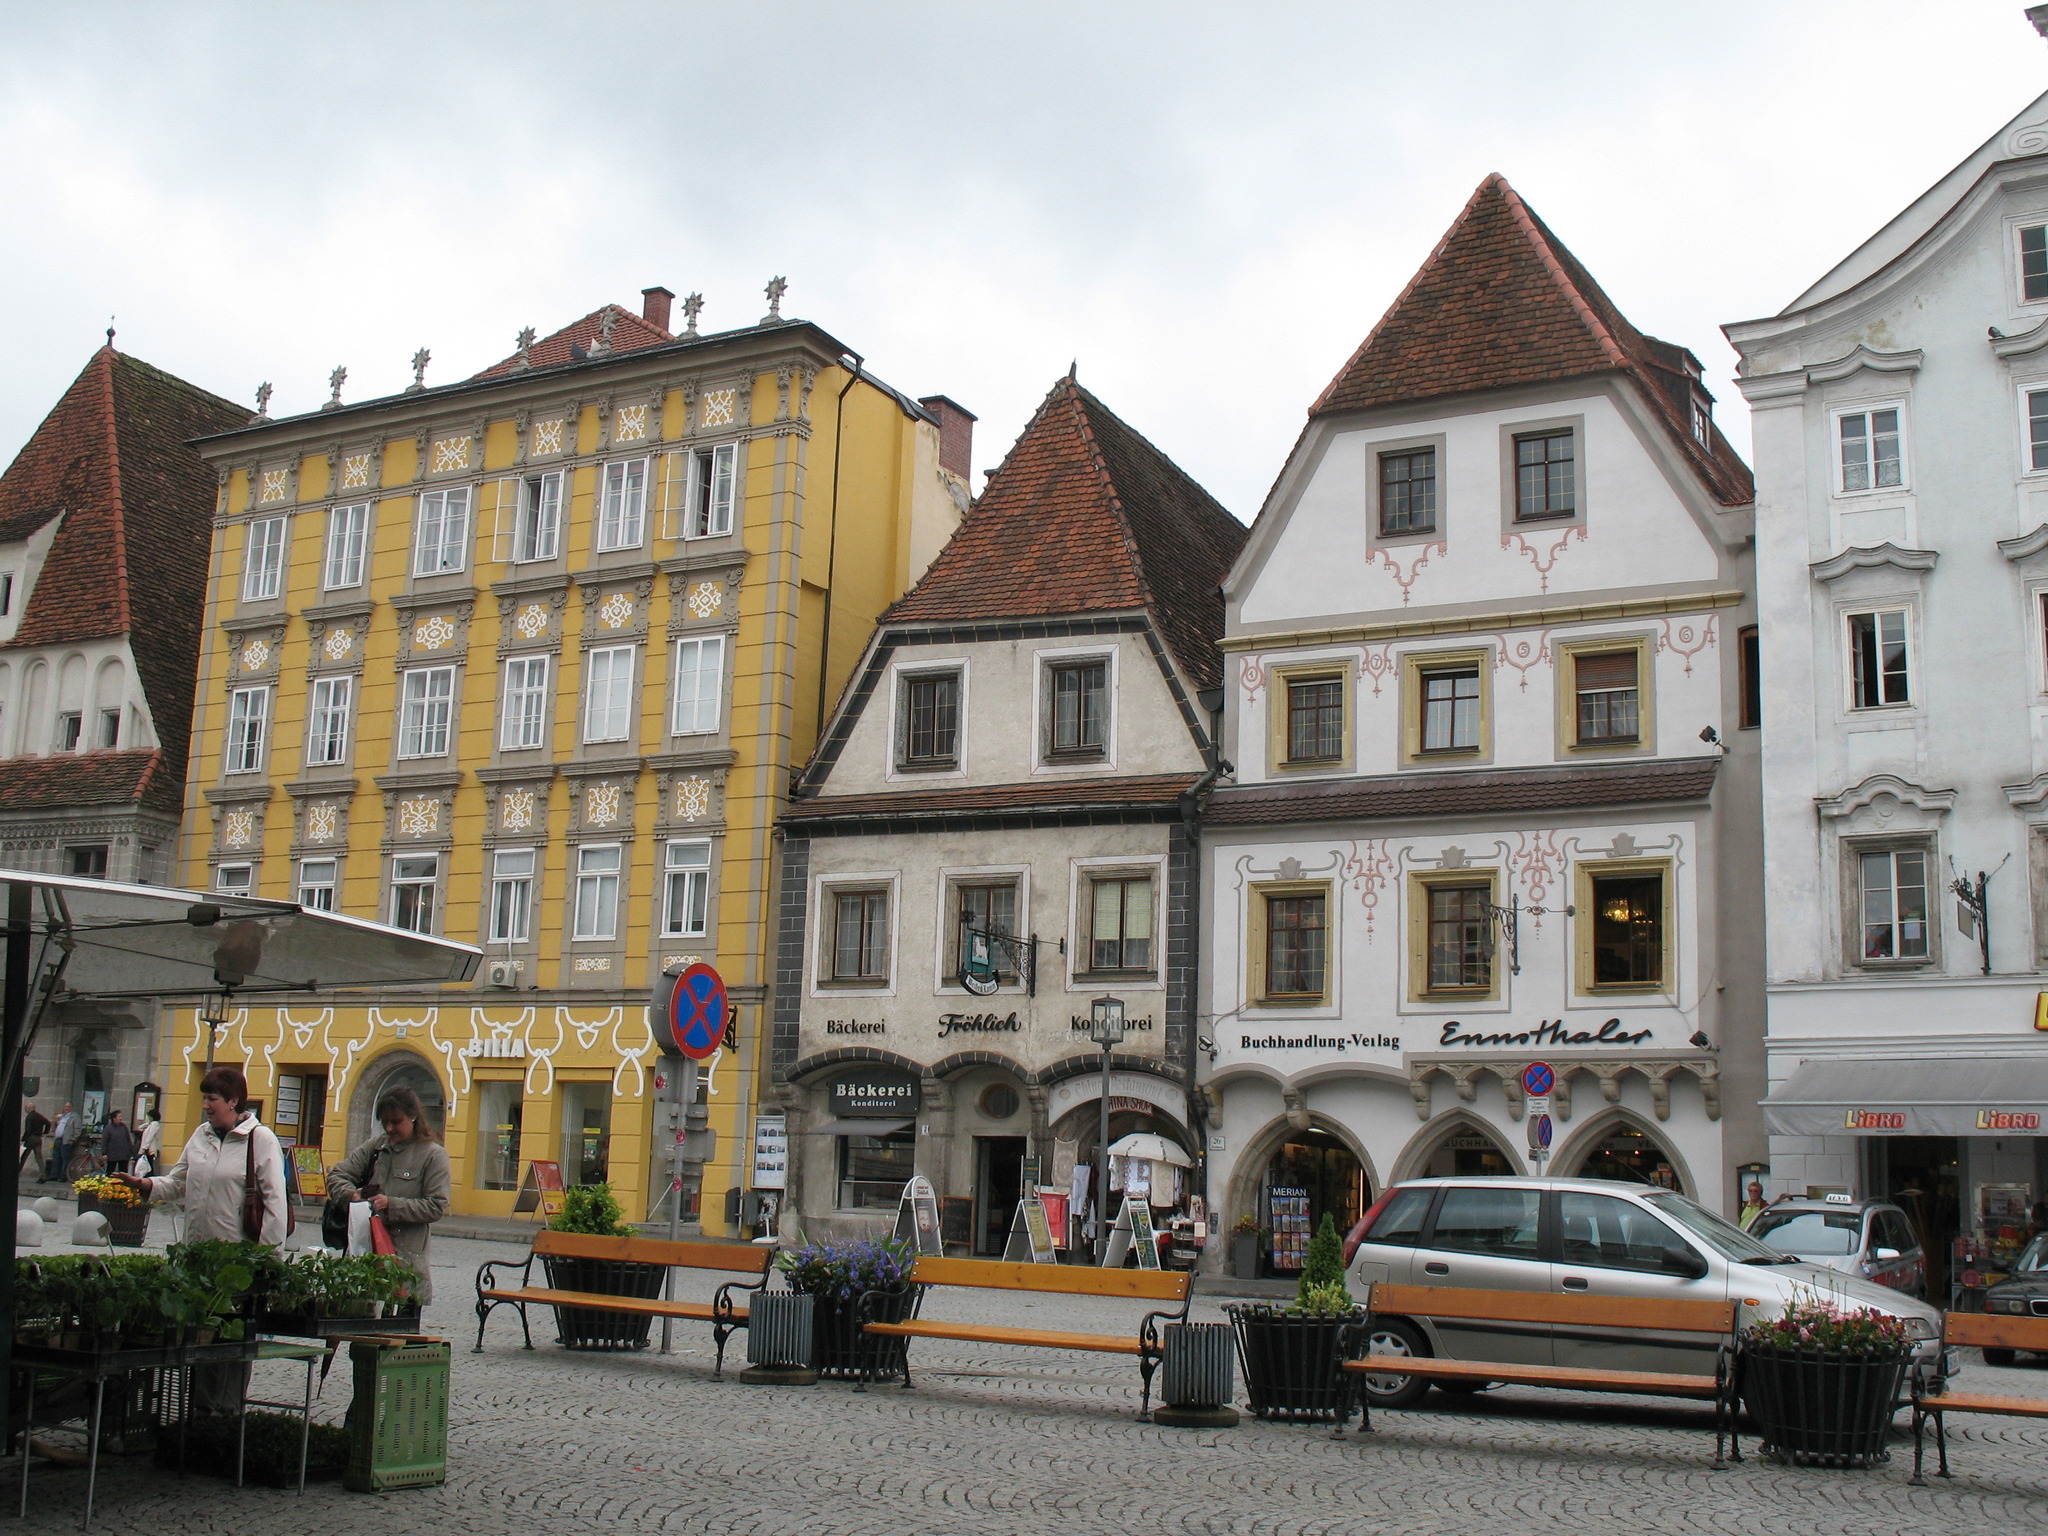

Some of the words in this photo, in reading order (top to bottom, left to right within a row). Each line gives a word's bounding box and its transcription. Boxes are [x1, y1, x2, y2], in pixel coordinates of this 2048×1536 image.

[827, 1018, 885, 1034] Bäckerei
[938, 1012, 1021, 1038] Fröhlich
[1440, 1018, 1653, 1046] Ennsthaler
[836, 1083, 912, 1097] Bäckerei
[1108, 1096, 1128, 1110] HINA
[1273, 1187, 1307, 1197] MERIAN
